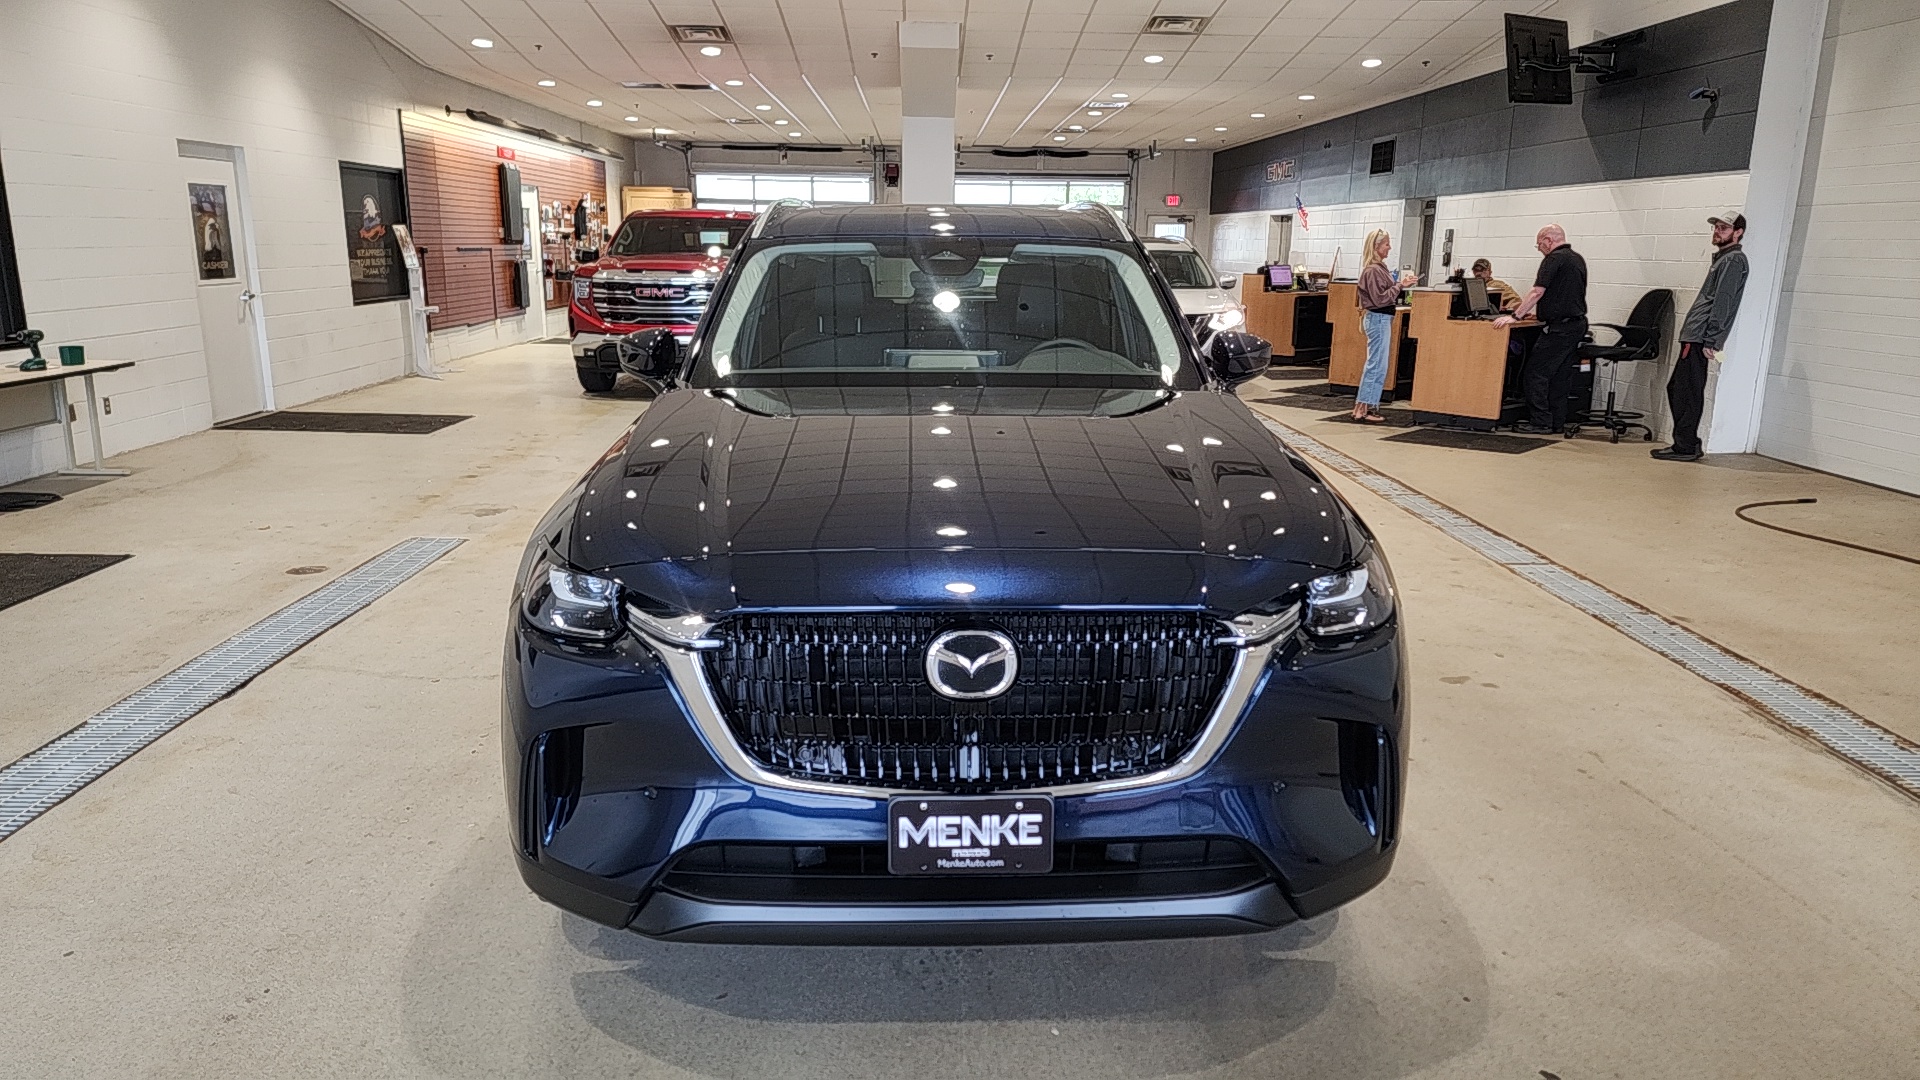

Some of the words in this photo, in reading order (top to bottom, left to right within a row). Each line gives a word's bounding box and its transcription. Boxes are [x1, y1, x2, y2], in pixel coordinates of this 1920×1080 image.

[1266, 160, 1295, 182] GMC
[202, 260, 230, 270] CASHIER
[635, 287, 685, 298] GMC
[898, 813, 1043, 849] MENKE
[937, 858, 1005, 869] MenkeAuto.com
